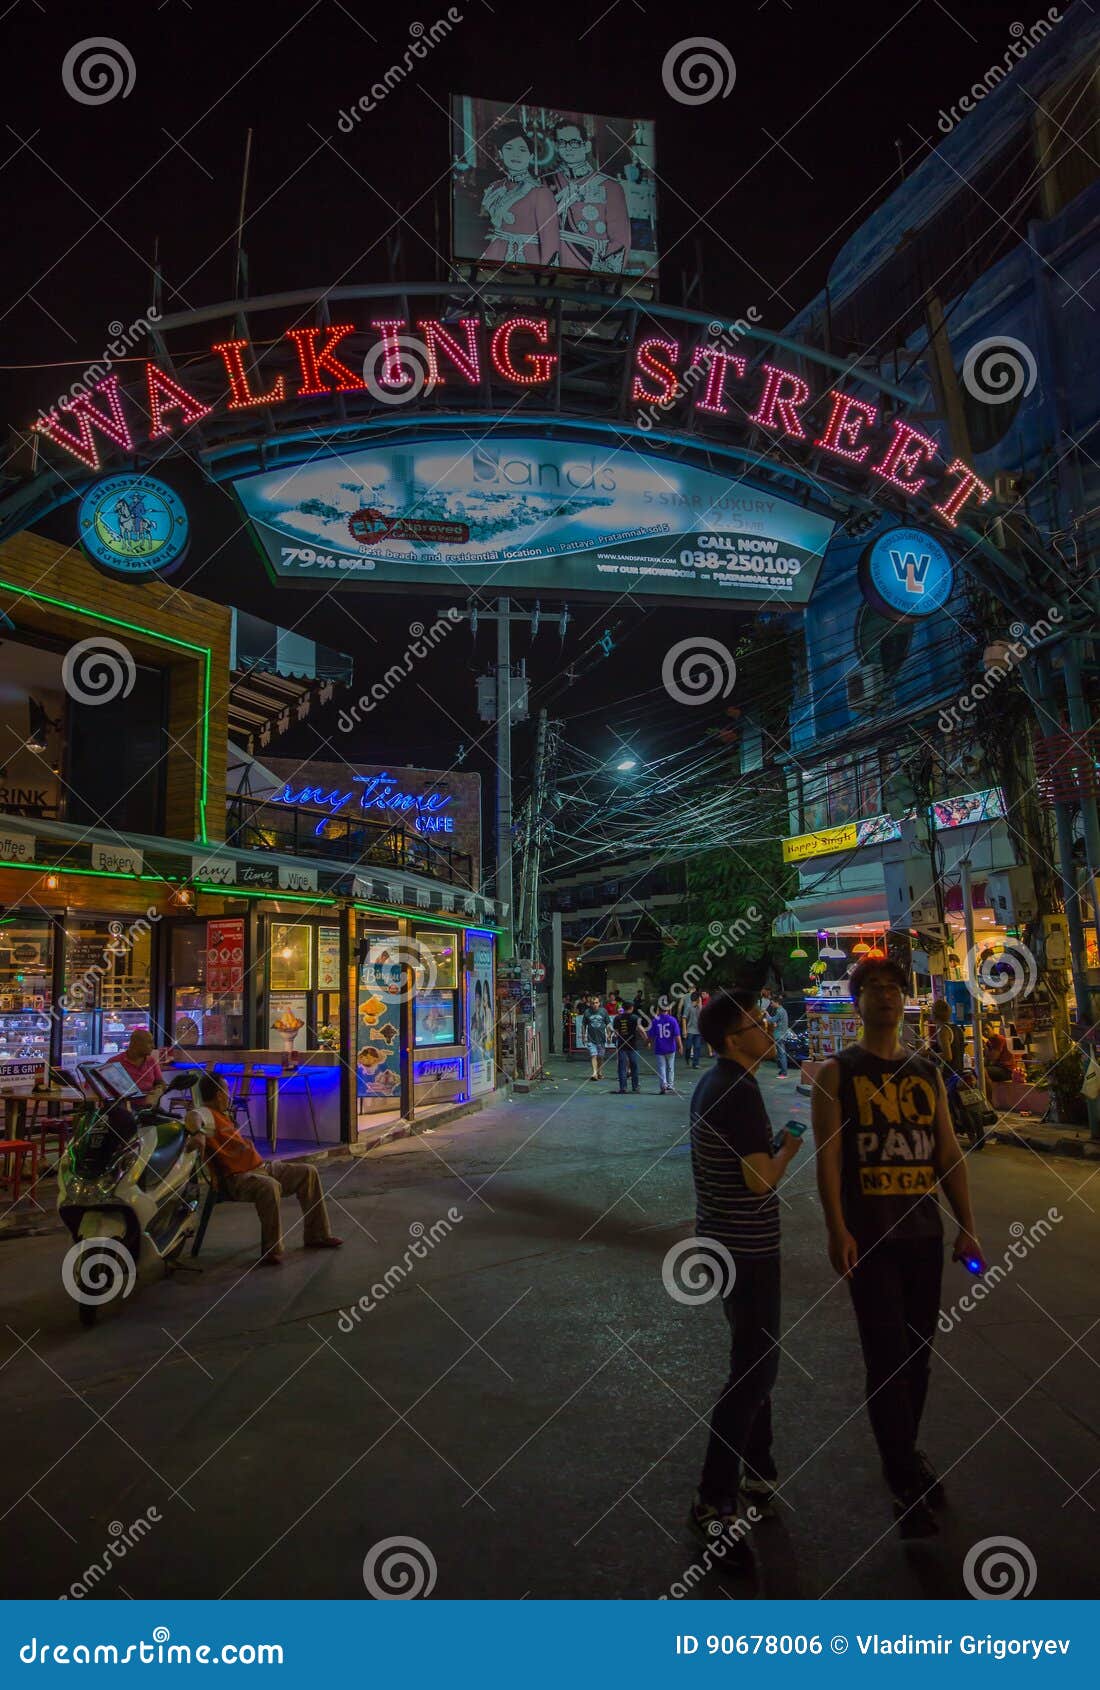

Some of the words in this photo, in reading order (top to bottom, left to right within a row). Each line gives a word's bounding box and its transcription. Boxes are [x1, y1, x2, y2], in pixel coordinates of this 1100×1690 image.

[30, 317, 559, 472] WALKING
[632, 335, 993, 528] STREET
[472, 449, 617, 492] Sands
[657, 493, 704, 509] STAR
[706, 496, 776, 513] LUXURY
[385, 549, 417, 561] beach
[446, 550, 499, 563] residential
[503, 547, 543, 559] location
[546, 545, 556, 554] in
[560, 538, 595, 552] Pattaya
[598, 527, 648, 544] Pratamnak
[697, 535, 736, 551] CALL
[738, 539, 779, 554] NOW
[596, 553, 677, 565] WWW.SANDSPATTAYA.COM
[680, 549, 801, 576] 038-250109
[415, 815, 454, 833] CAFE
[100, 853, 134, 869] Bakery
[288, 872, 309, 886] Wine
[657, 1023, 671, 1038] 16
[22, 1063, 42, 1074] GRI
[853, 1072, 937, 1127] NO
[863, 1172, 892, 1190] NO
